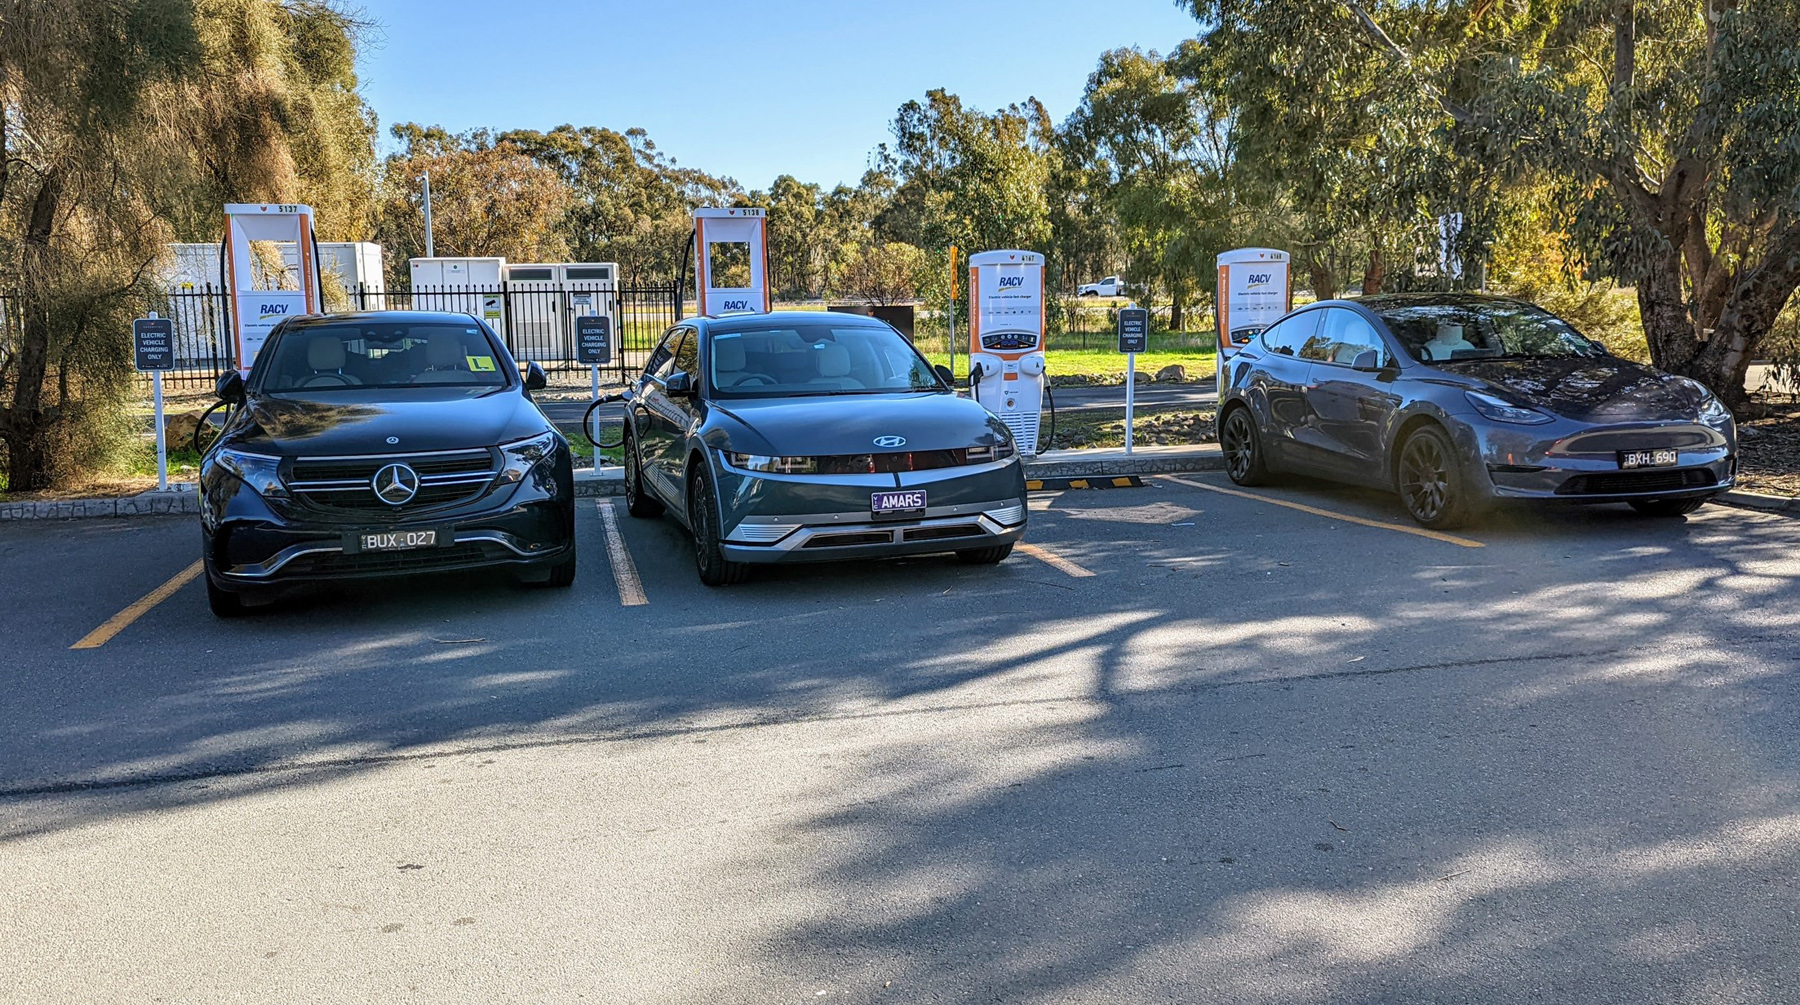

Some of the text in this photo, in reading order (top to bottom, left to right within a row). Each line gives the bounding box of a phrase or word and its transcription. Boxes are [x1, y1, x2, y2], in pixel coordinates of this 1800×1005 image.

[999, 277, 1024, 286] RACV
[1248, 274, 1271, 283] RACV
[260, 304, 289, 314] RACV
[724, 300, 748, 310] RACV
[472, 358, 489, 369] L
[1628, 451, 1676, 464] BXH 690
[882, 494, 922, 508] AMARS
[367, 531, 436, 548] BUX 027
